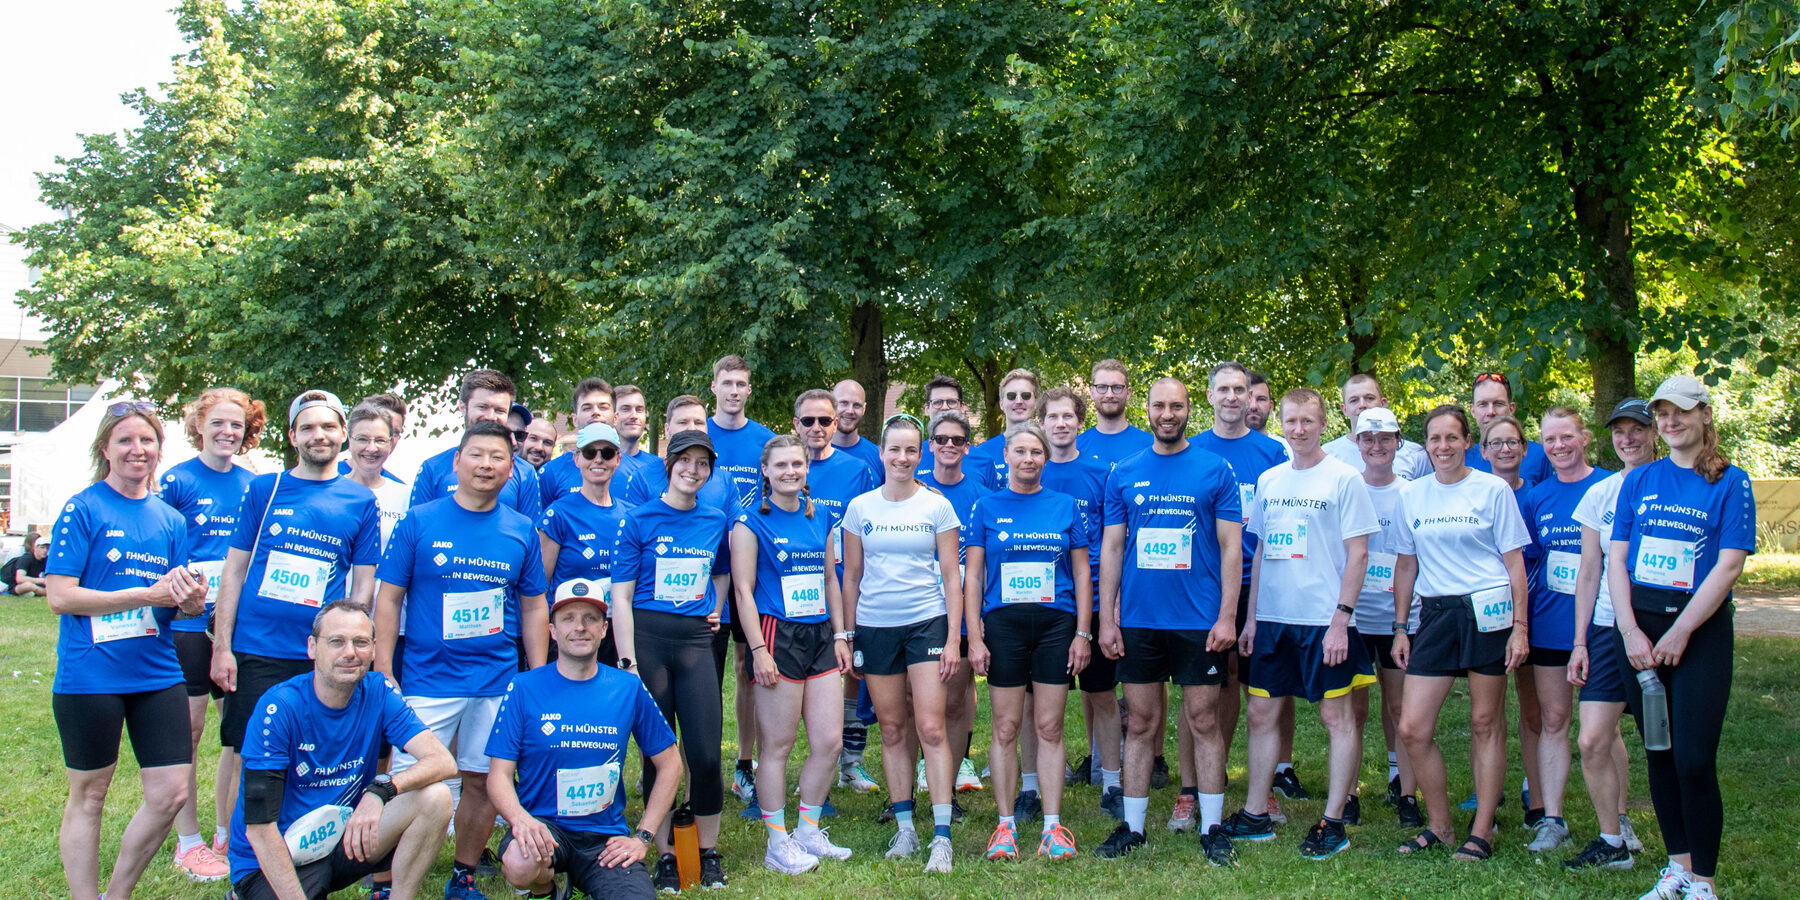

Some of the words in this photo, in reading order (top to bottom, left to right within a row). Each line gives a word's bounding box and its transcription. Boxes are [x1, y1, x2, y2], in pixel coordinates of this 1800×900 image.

[729, 465, 758, 474] MÜNSTER
[1161, 494, 1195, 503] MÜNSTER
[1282, 497, 1328, 511] MÜNSTER
[1664, 504, 1708, 520] MÜNSTER
[1437, 515, 1480, 525] MÜNSTER
[1657, 519, 1704, 535] BEWEGUNG!
[286, 526, 300, 536] FH
[301, 529, 342, 546] MÜNSTER
[1026, 532, 1062, 540] MÜNSTER
[1267, 533, 1293, 546] 4476
[294, 544, 338, 560] BEWEGUNG!
[801, 550, 826, 559] MÜNSTE
[1144, 543, 1177, 555] 4492
[453, 556, 466, 564] FH
[468, 558, 510, 571] MÜNSTER
[1642, 552, 1677, 570] 4479
[270, 568, 310, 588] 4500
[1366, 565, 1392, 578] 485
[1553, 565, 1576, 580] 451
[664, 573, 698, 586] 4497
[1009, 576, 1041, 589] 4505
[792, 588, 819, 601] 4488
[452, 606, 490, 622] 4512
[575, 724, 618, 735] MÜNSTER
[298, 743, 315, 751] JAO
[571, 741, 617, 750] BEWEGUNG!
[314, 767, 325, 775] FH
[566, 782, 605, 800] 4473
[299, 821, 336, 851] 4482
